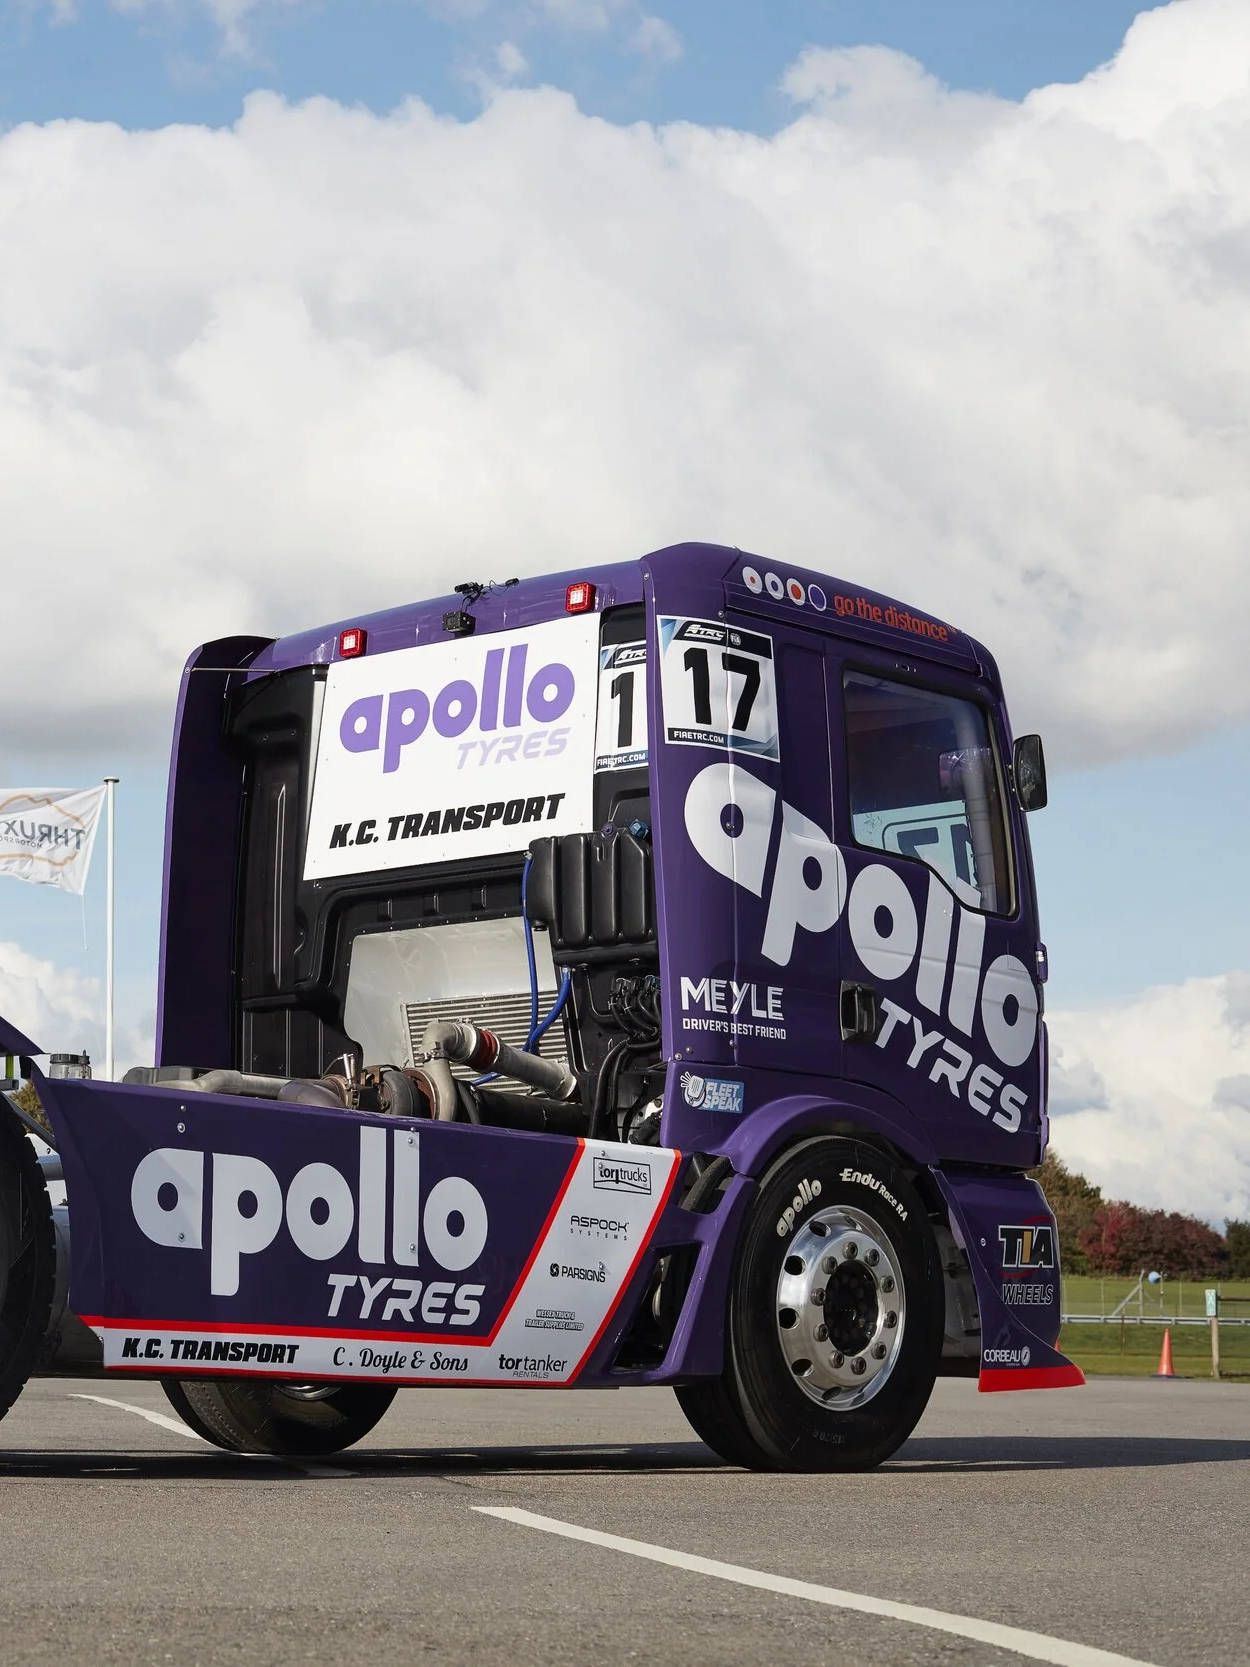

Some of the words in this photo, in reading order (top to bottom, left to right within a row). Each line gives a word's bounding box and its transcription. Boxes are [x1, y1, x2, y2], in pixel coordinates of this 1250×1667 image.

[834, 595, 854, 617] go
[856, 598, 882, 622] the
[339, 643, 575, 773] apollo
[684, 647, 761, 731] 17
[456, 727, 571, 770] TYRES
[329, 822, 380, 849] K.C.
[387, 793, 565, 841] TRANSPORT
[684, 763, 1037, 1067] apollo
[680, 977, 784, 1021] MEYLE
[730, 1023, 753, 1036] BEST
[755, 1026, 786, 1040] FRIEND
[875, 998, 1028, 1133] TYRES
[704, 1096, 741, 1112] SPEAK
[705, 1082, 740, 1098] FLEET
[131, 1125, 488, 1297] apollo
[776, 1178, 822, 1237] apollo
[998, 1225, 1054, 1268] TIA
[561, 1266, 606, 1283] PARSIGNS
[1002, 1284, 1054, 1305] WHEELS
[327, 1273, 486, 1326] TYRES
[122, 1337, 164, 1360] K.C.
[170, 1339, 299, 1364] TRANSPORT
[359, 1347, 408, 1375] Doyle
[411, 1351, 426, 1370] &
[429, 1351, 469, 1373] Sons
[984, 1349, 1020, 1362] CORBEAU
[513, 1371, 549, 1379] RENTALS
